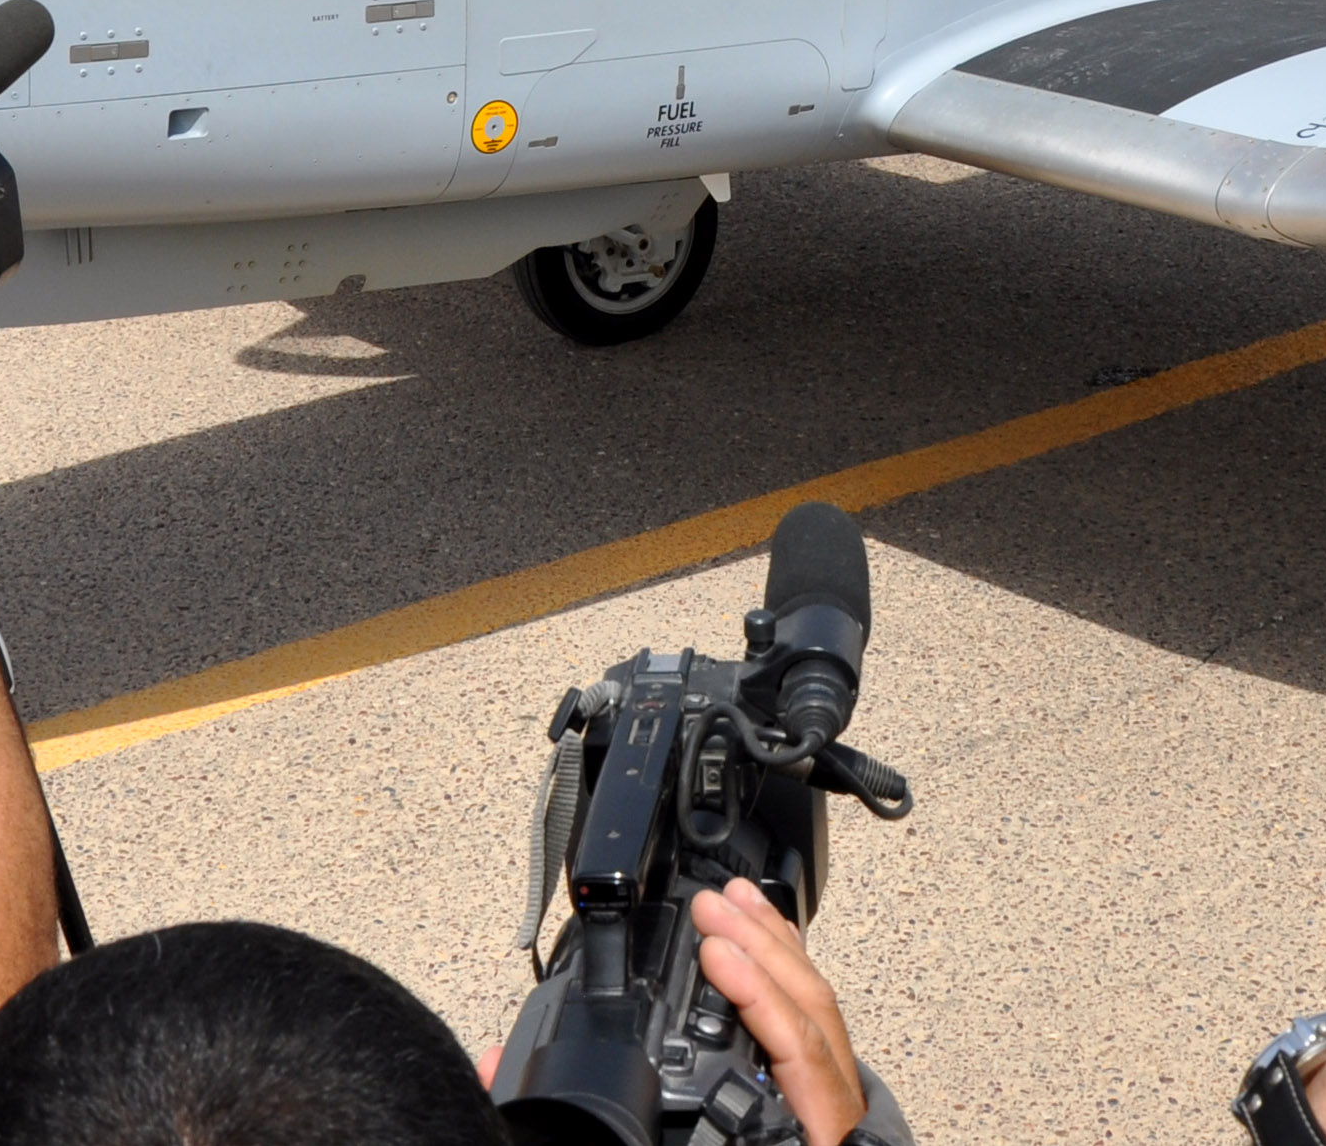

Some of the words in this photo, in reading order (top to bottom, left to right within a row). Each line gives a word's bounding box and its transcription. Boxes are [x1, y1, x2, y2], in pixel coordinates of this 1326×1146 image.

[312, 14, 339, 22] BATTERY
[657, 101, 697, 122] FUEL
[647, 121, 703, 139] PRESSURE
[660, 137, 681, 149] FILL
